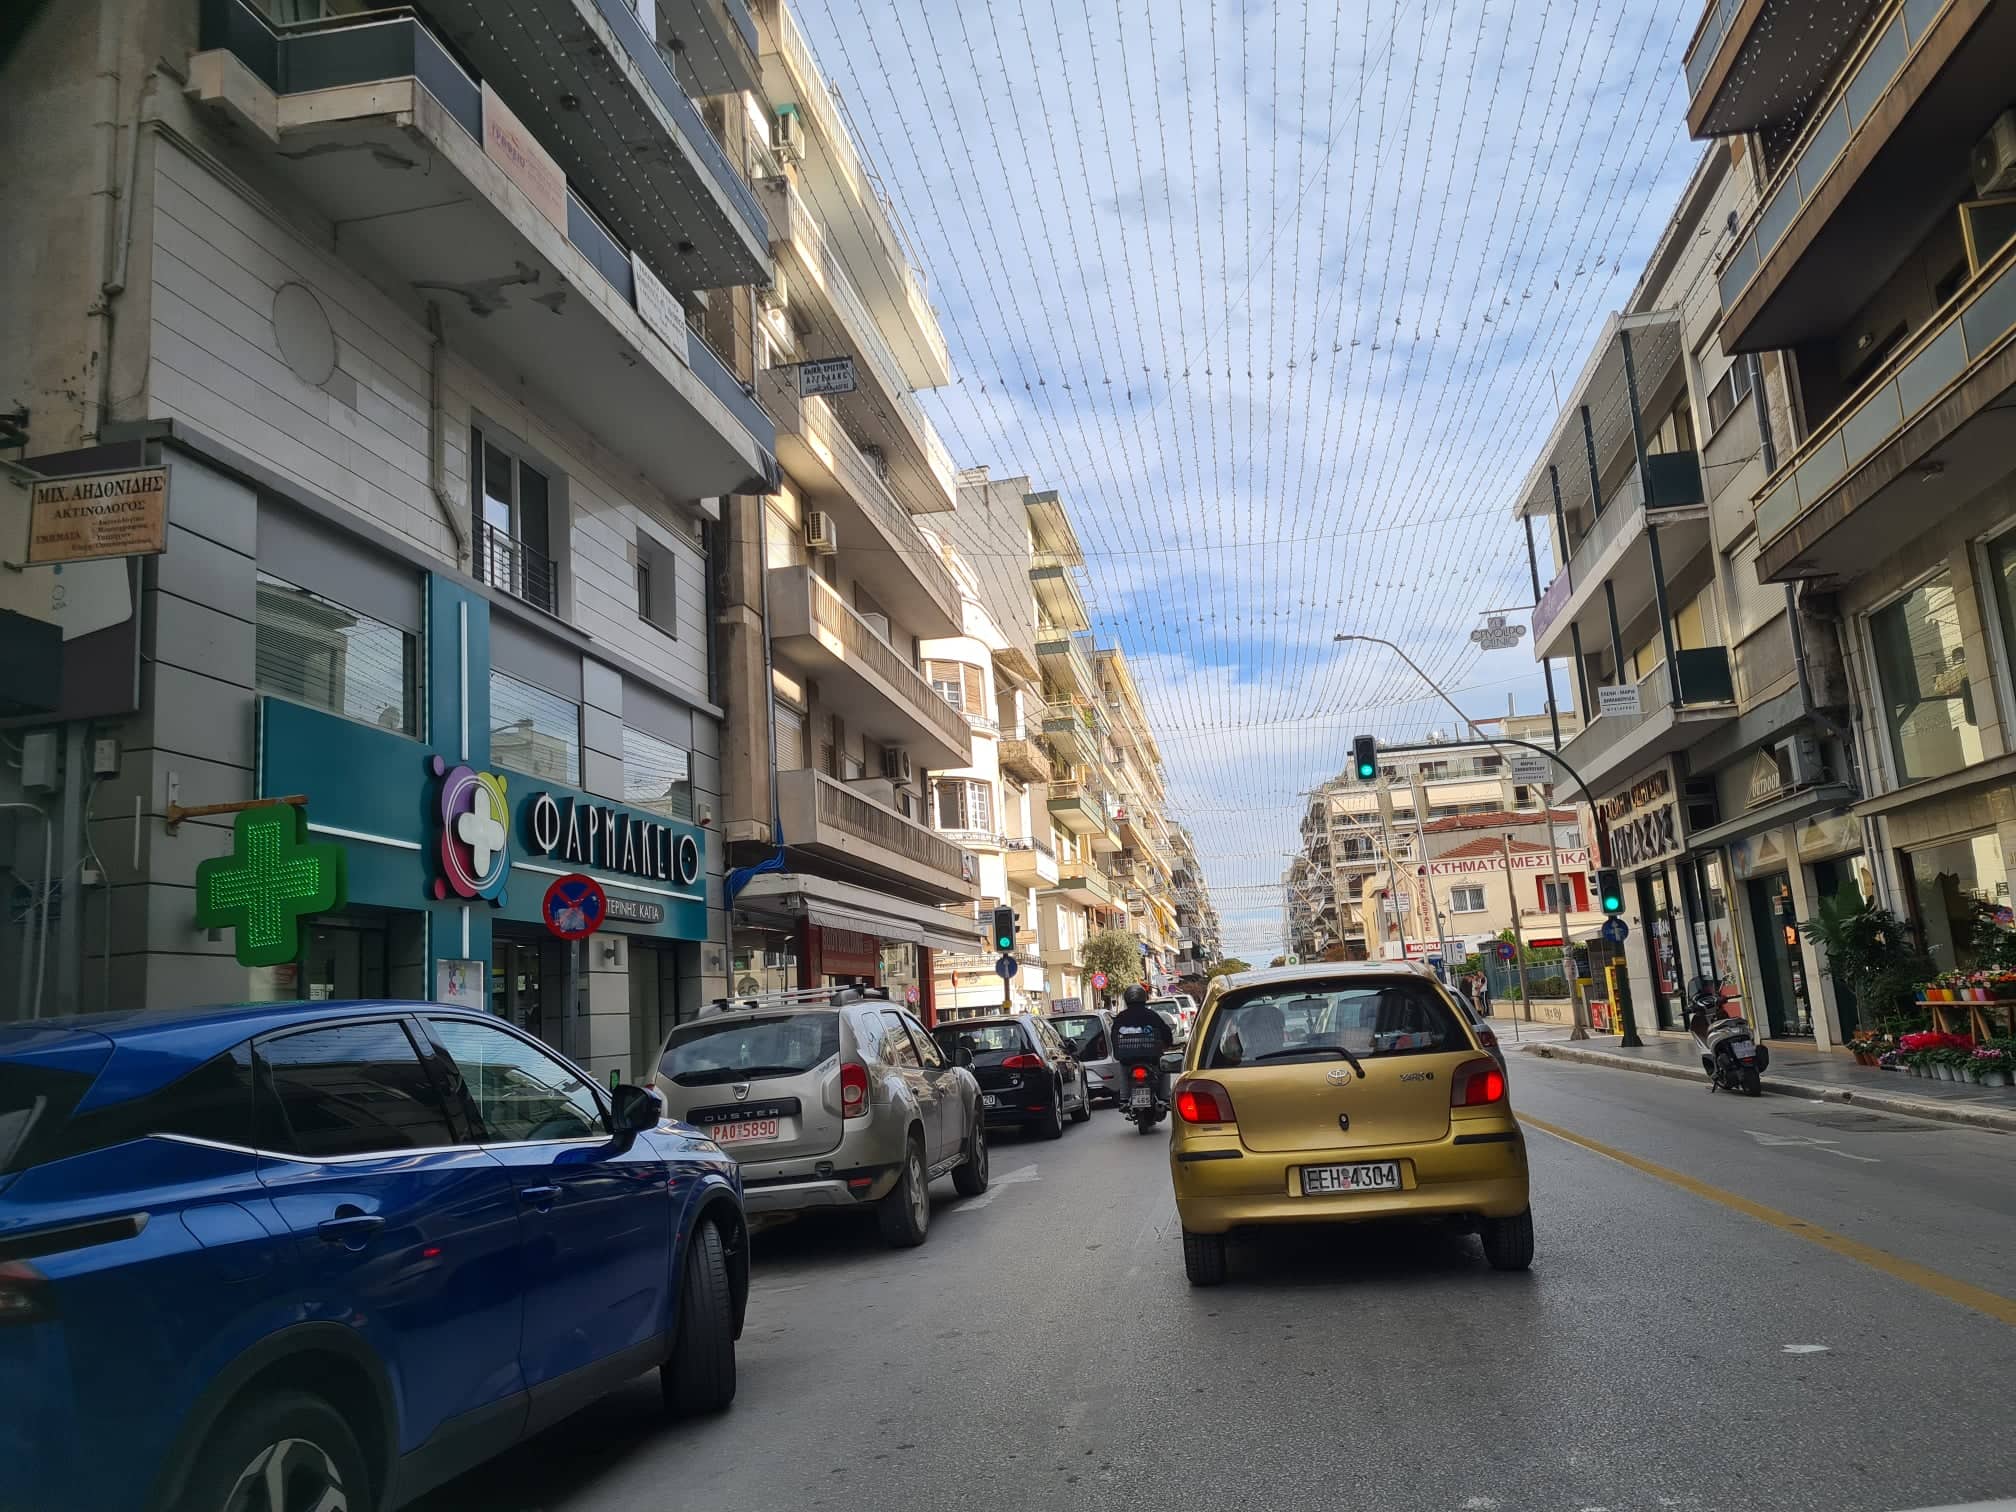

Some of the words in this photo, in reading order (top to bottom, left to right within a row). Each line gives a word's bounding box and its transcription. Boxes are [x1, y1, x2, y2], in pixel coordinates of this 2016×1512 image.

[38, 486, 69, 504] ΜΙΧ.
[70, 476, 163, 501] ΑΗΔΟΝΙΔΗΣ
[54, 501, 145, 519] ΑΚΤΙΝΟΛΟΓΟΣ
[1752, 773, 1780, 797] OUTDOOR
[533, 791, 699, 886] ΦΑΡΜΑΚΕΙΟ
[1431, 851, 1586, 874] ΚΤΗΜΑΤΟΜΕΣΙΙΚΑ
[704, 1108, 779, 1122] DUSTER
[743, 1120, 776, 1138] 5890
[1306, 1169, 1341, 1190] EEH
[1350, 1165, 1396, 1188] 4304
